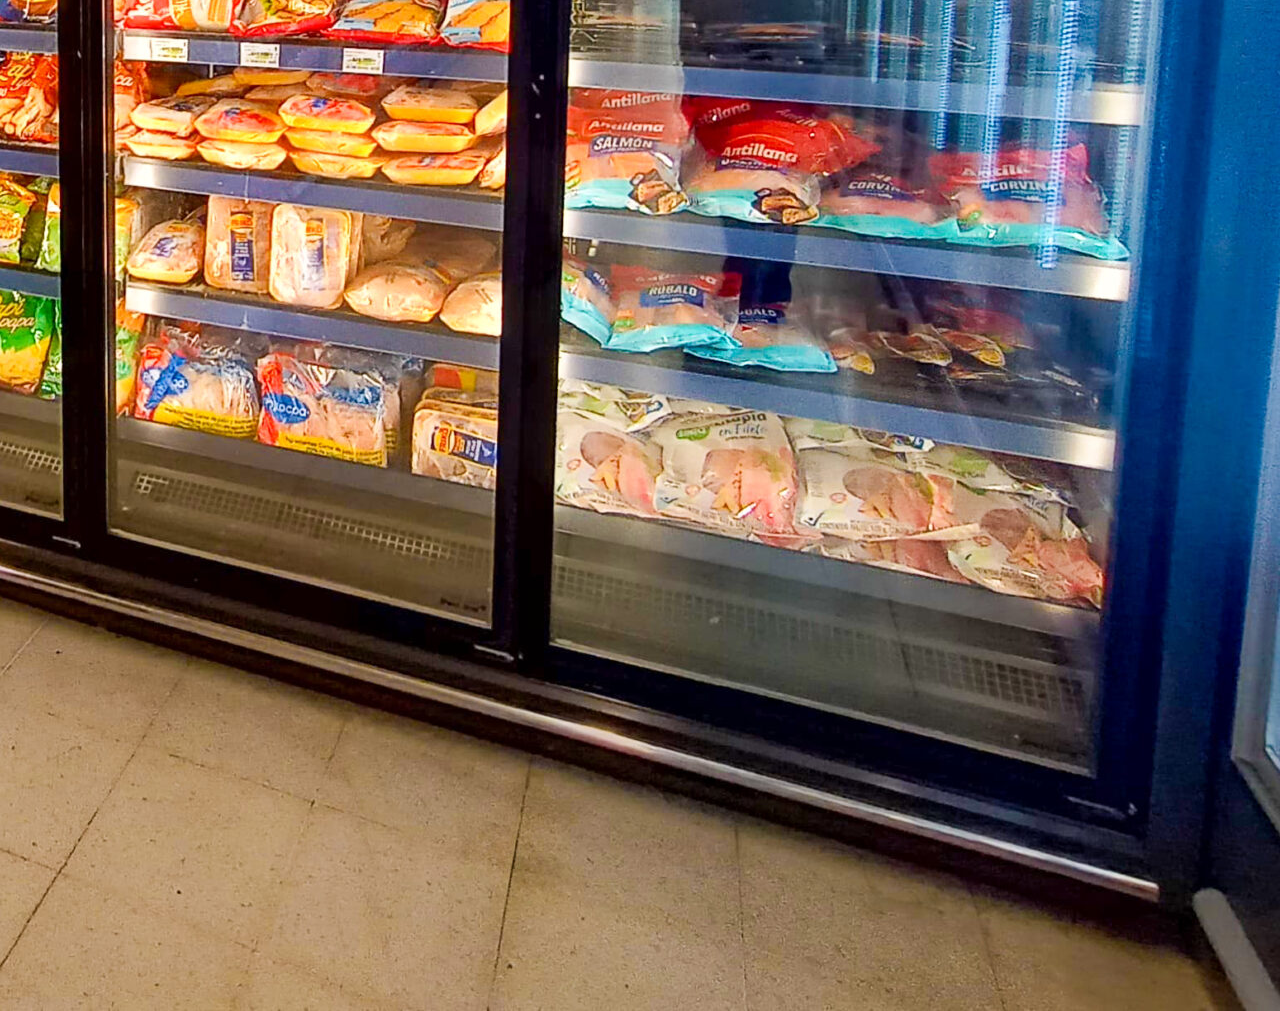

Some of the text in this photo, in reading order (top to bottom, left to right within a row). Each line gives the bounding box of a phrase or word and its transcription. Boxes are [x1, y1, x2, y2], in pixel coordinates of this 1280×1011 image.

[601, 92, 673, 109] Antillana
[721, 143, 799, 164] Antillana
[989, 180, 1057, 193] CORVIN
